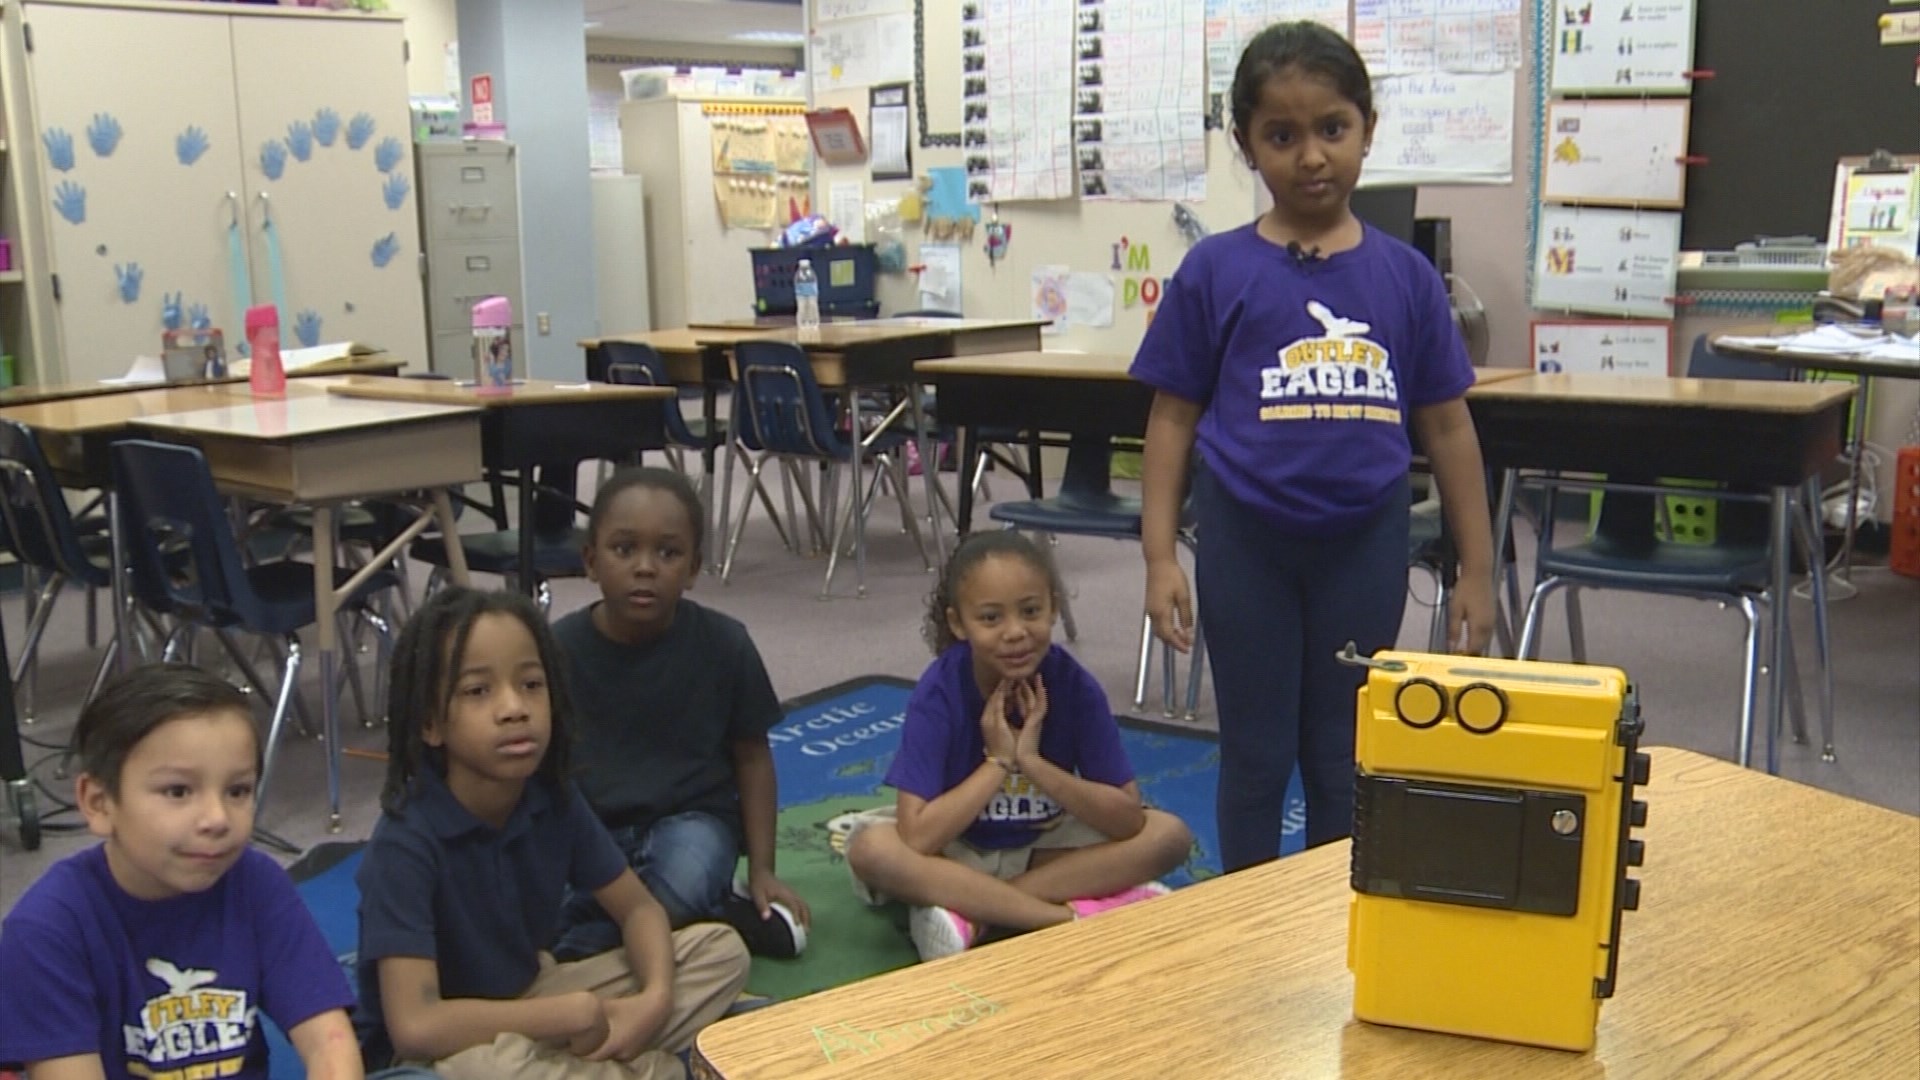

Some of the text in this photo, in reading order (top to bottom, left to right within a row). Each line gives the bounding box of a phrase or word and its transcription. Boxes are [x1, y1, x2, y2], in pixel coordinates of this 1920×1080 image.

[1111, 236, 1150, 271] I'M
[1260, 363, 1398, 401] EAGLES
[767, 701, 876, 749] Arctic
